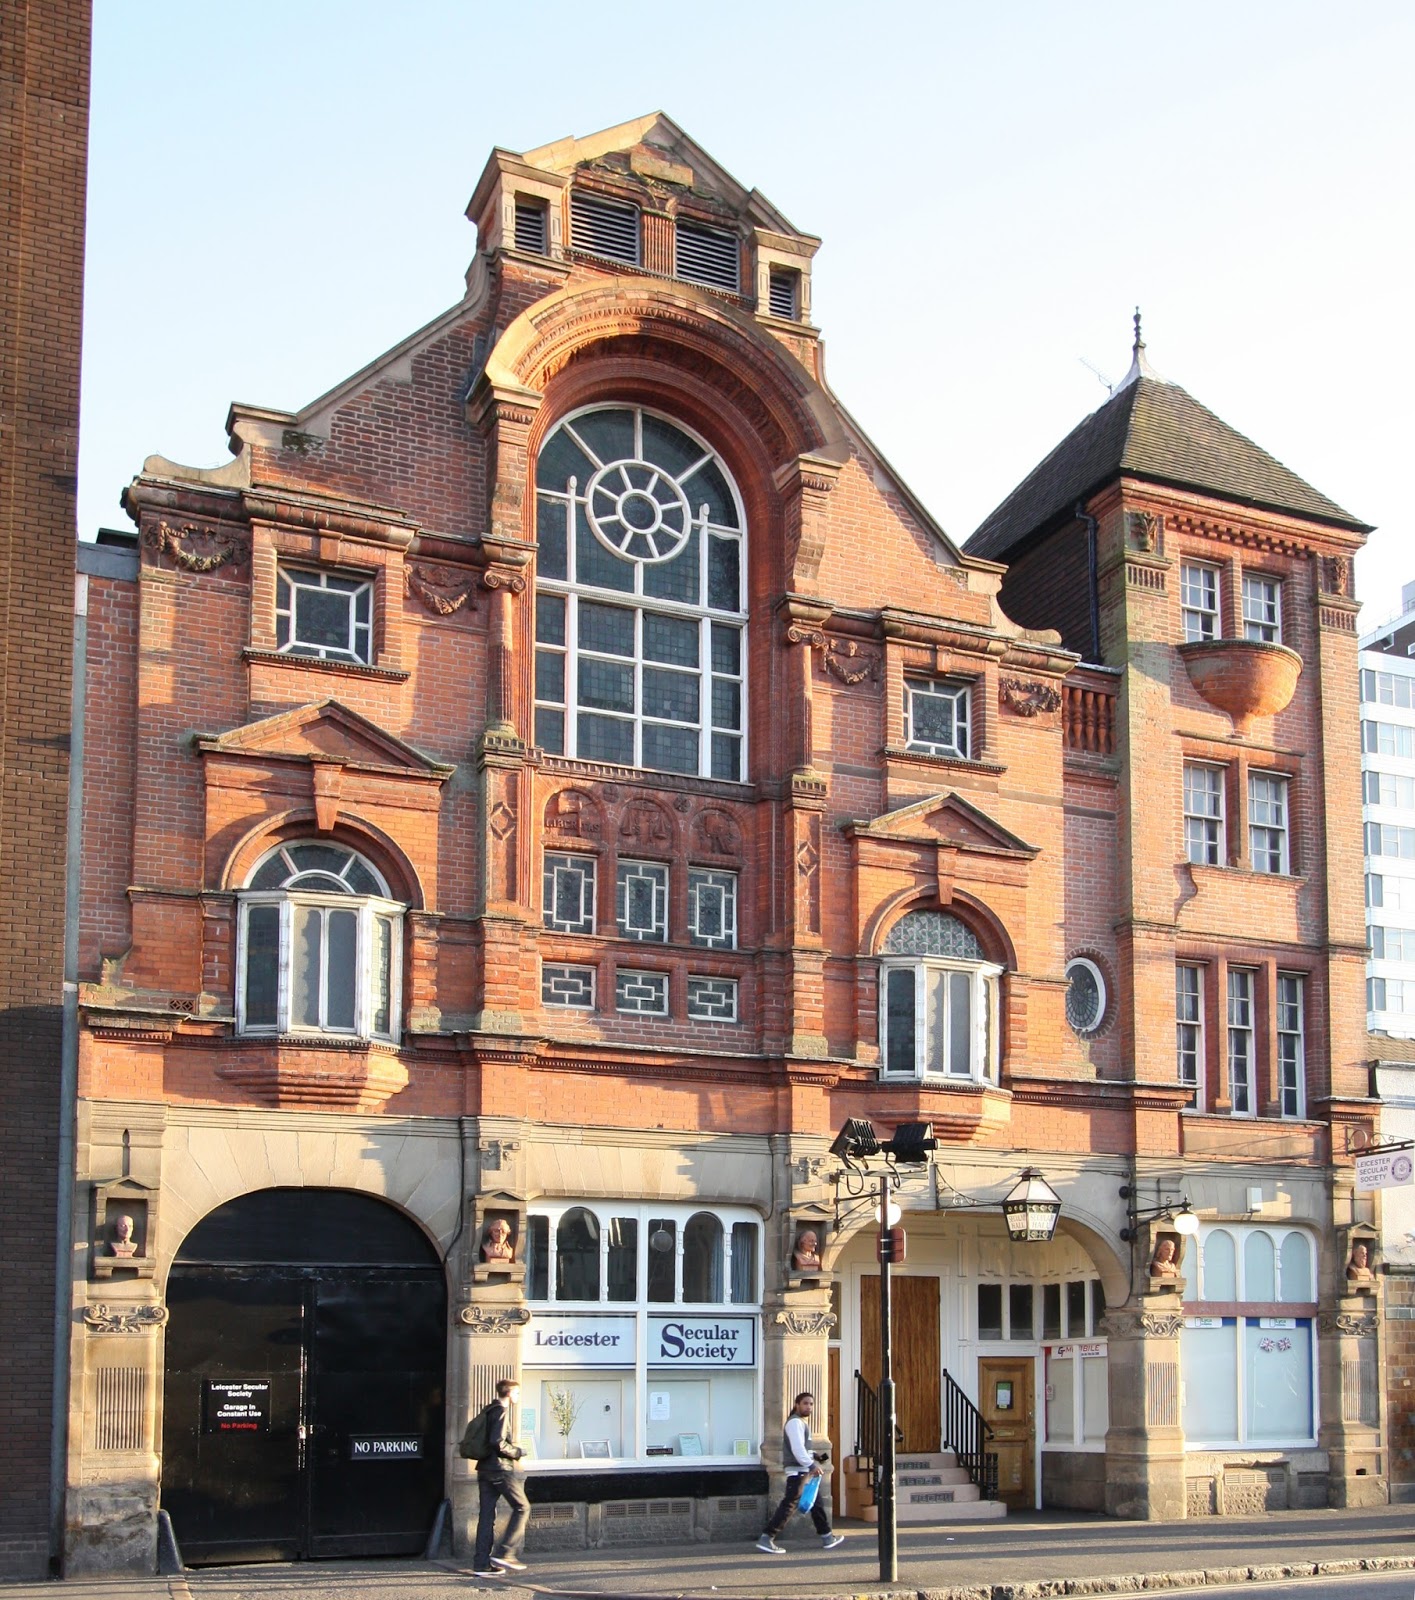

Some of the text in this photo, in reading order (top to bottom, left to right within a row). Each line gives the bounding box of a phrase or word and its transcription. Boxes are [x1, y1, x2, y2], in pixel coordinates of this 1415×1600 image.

[1356, 1157, 1391, 1168] LEICESTER
[1359, 1165, 1389, 1176] SECULAR
[1360, 1173, 1387, 1183] SOCIETY
[534, 1330, 620, 1347] Leicester
[661, 1323, 740, 1348] Secular
[661, 1338, 738, 1361] Society
[354, 1441, 418, 1453] NO PARKING
